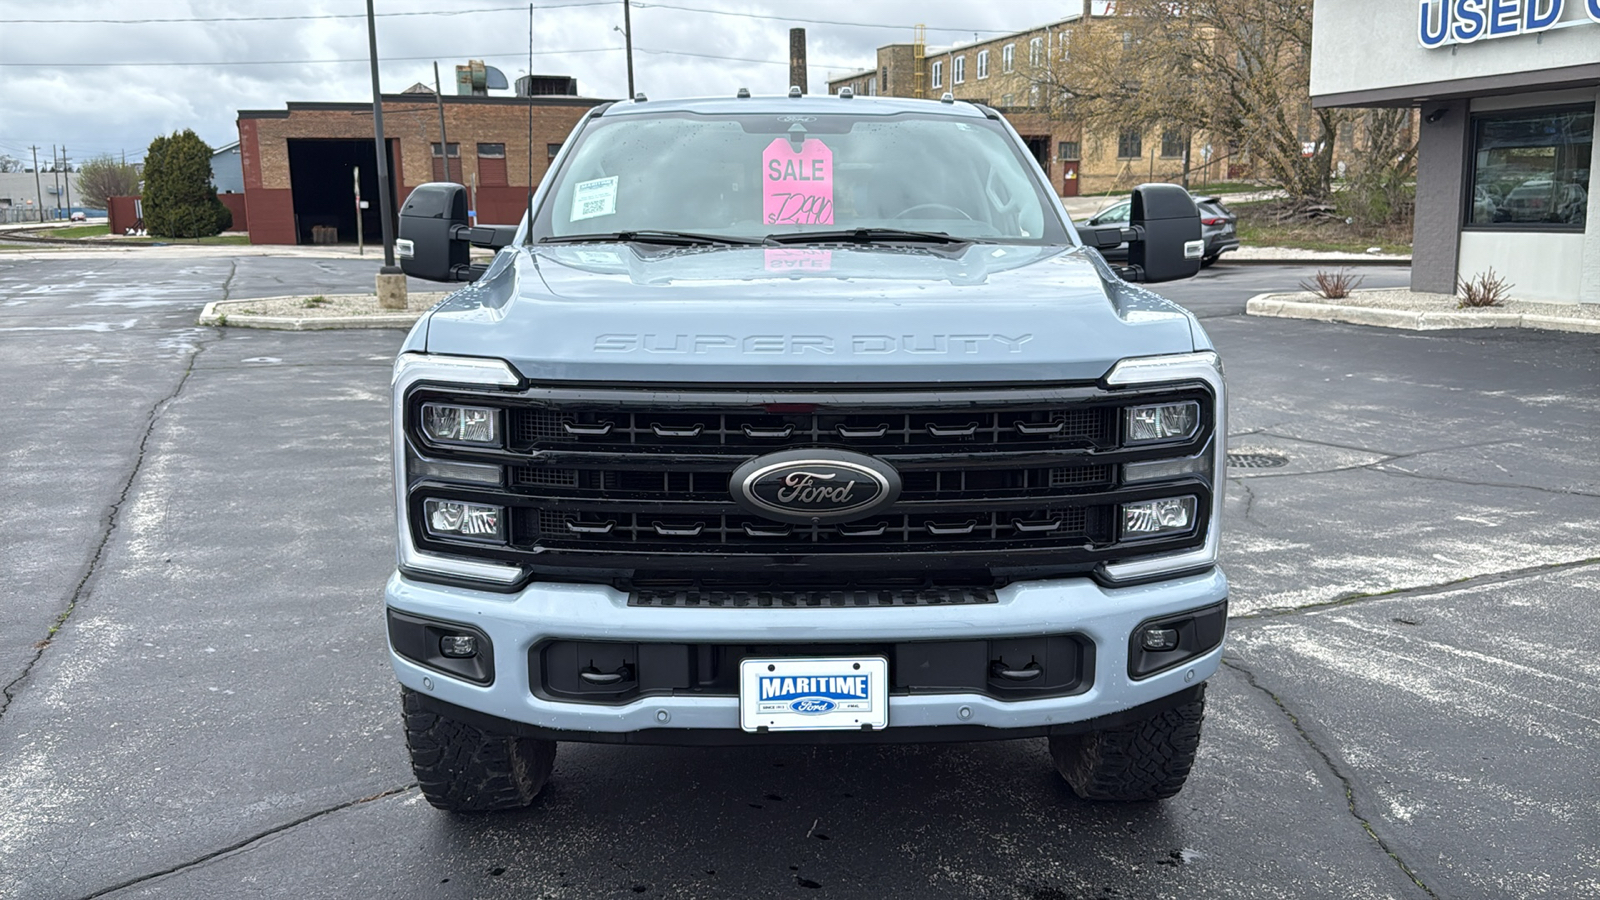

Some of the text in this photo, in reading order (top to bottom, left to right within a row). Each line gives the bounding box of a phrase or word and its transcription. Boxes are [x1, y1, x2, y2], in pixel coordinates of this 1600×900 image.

[1418, 0, 1564, 48] USED
[768, 159, 825, 181] SALE
[593, 332, 1034, 355] SUPER DUTY
[777, 471, 855, 503] Ford
[762, 677, 866, 699] MARITIME
[798, 700, 828, 711] Ford
